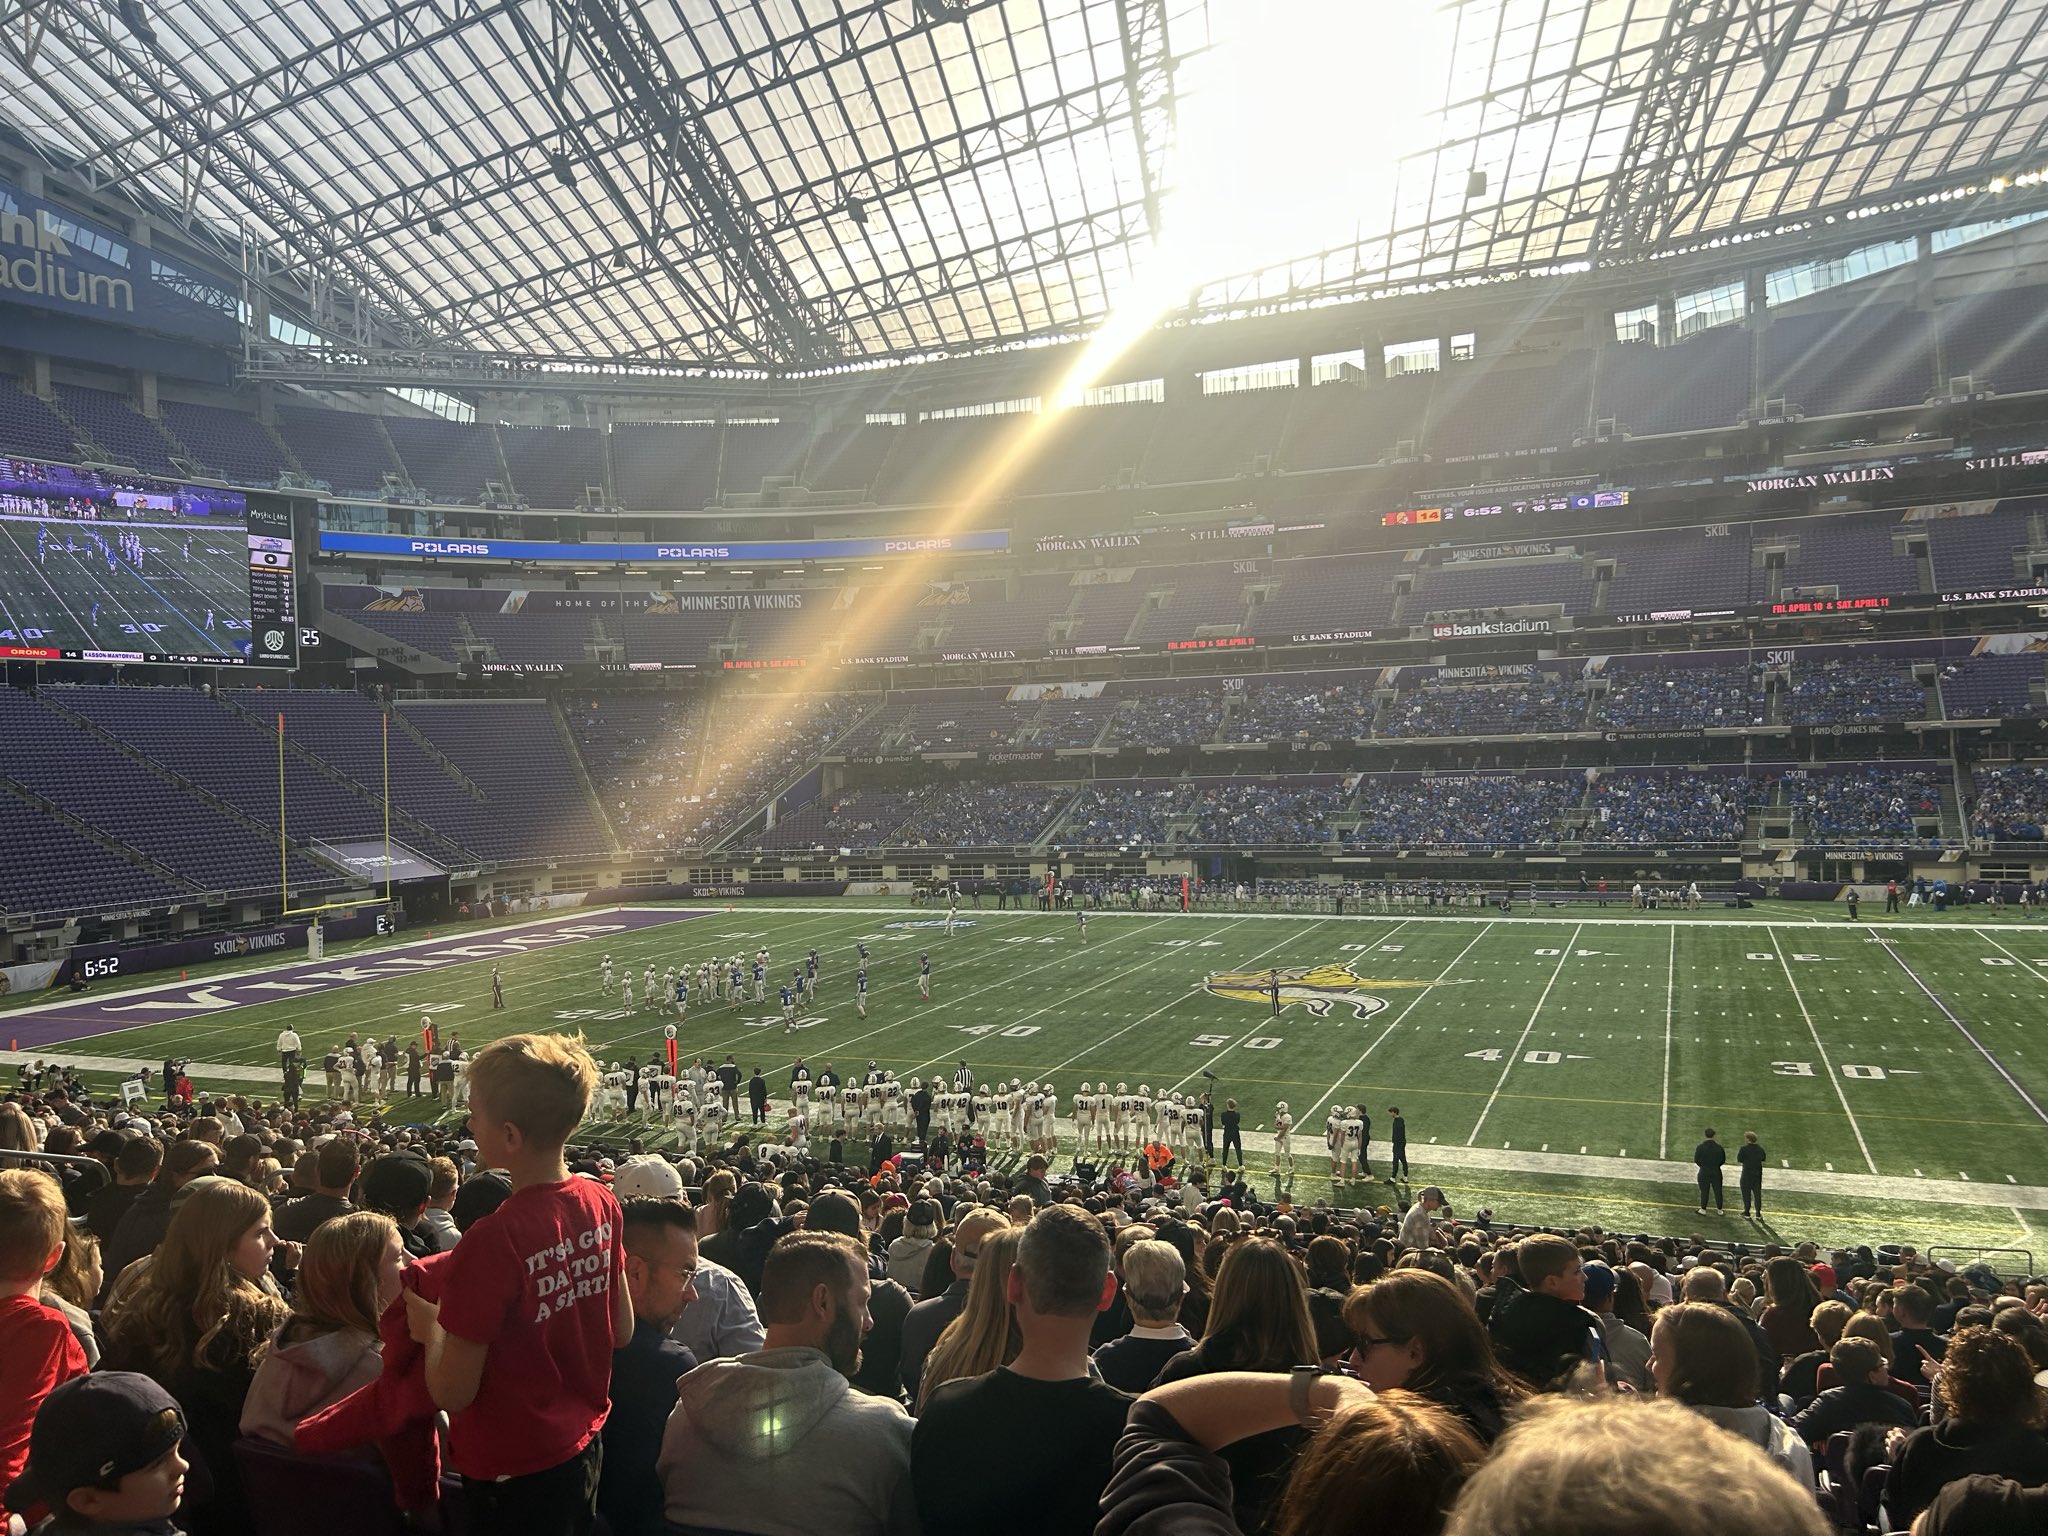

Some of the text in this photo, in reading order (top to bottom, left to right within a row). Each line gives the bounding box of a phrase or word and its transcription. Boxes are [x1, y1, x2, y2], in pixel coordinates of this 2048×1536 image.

[1966, 456, 2020, 470] STILL
[1747, 466, 1894, 493] MORGAN WALLEN
[1578, 498, 1588, 506] 0
[1464, 506, 1502, 517] 6:52
[1705, 524, 1730, 536] SKOL
[1190, 530, 1228, 541] STILL
[412, 542, 488, 554] POLARIS
[886, 538, 951, 552] POLARIS
[1036, 536, 1141, 552] MORGAN WALLEN
[658, 548, 729, 558] POLARIS
[1452, 543, 1551, 560] MINNESOTA VIKINGS
[264, 554, 278, 564] 0
[1233, 560, 1258, 573] SKOL
[1965, 592, 1997, 600] BANK
[682, 595, 750, 611] MINNESOTA
[754, 594, 802, 609] VIKINGS
[1772, 604, 1787, 613] FRI.
[1788, 603, 1812, 612] APRIL
[1814, 602, 1823, 611] 10
[1854, 599, 1879, 608] APRIL
[1881, 598, 1888, 607] 11
[1617, 614, 1650, 623] STILL
[302, 629, 320, 645] 25
[1334, 631, 1372, 639] STADIUM
[84, 652, 143, 660] KASSON-MANTORVILLE
[980, 651, 1015, 659] WALLEN
[1438, 664, 1534, 678] MINNESOTA VIKINGS
[1810, 726, 1830, 735] LAND
[1844, 725, 1867, 734] LAKES
[1292, 742, 1306, 751] Lite
[852, 755, 912, 764] sleep number
[988, 751, 1043, 762] ticketmaster
[1825, 852, 1903, 860] MINNESOTA VIKINGS
[693, 887, 744, 896] SKOL VIKINGS
[132, 909, 150, 920] VIKINGS
[214, 932, 285, 955] SKOL VIKINGS
[85, 957, 119, 978] 6:52
[609, 1077, 618, 1086] 71
[660, 1080, 669, 1090] 10
[797, 1085, 808, 1095] 30
[888, 1087, 898, 1096] 22
[819, 1091, 830, 1100] 34
[846, 1093, 857, 1102] 58
[957, 1098, 966, 1108] 42
[1078, 1101, 1088, 1110] 31
[1102, 1099, 1106, 1109] 1
[1134, 1101, 1144, 1111] 29
[673, 1105, 683, 1116] 69
[708, 1107, 719, 1117] 25
[1187, 1114, 1198, 1124] 50
[1347, 1126, 1360, 1137] 37
[761, 1147, 767, 1157] 8
[526, 1243, 566, 1275] IT'S
[565, 1238, 574, 1254] A
[571, 1255, 599, 1277] TO
[535, 1302, 551, 1322] A
